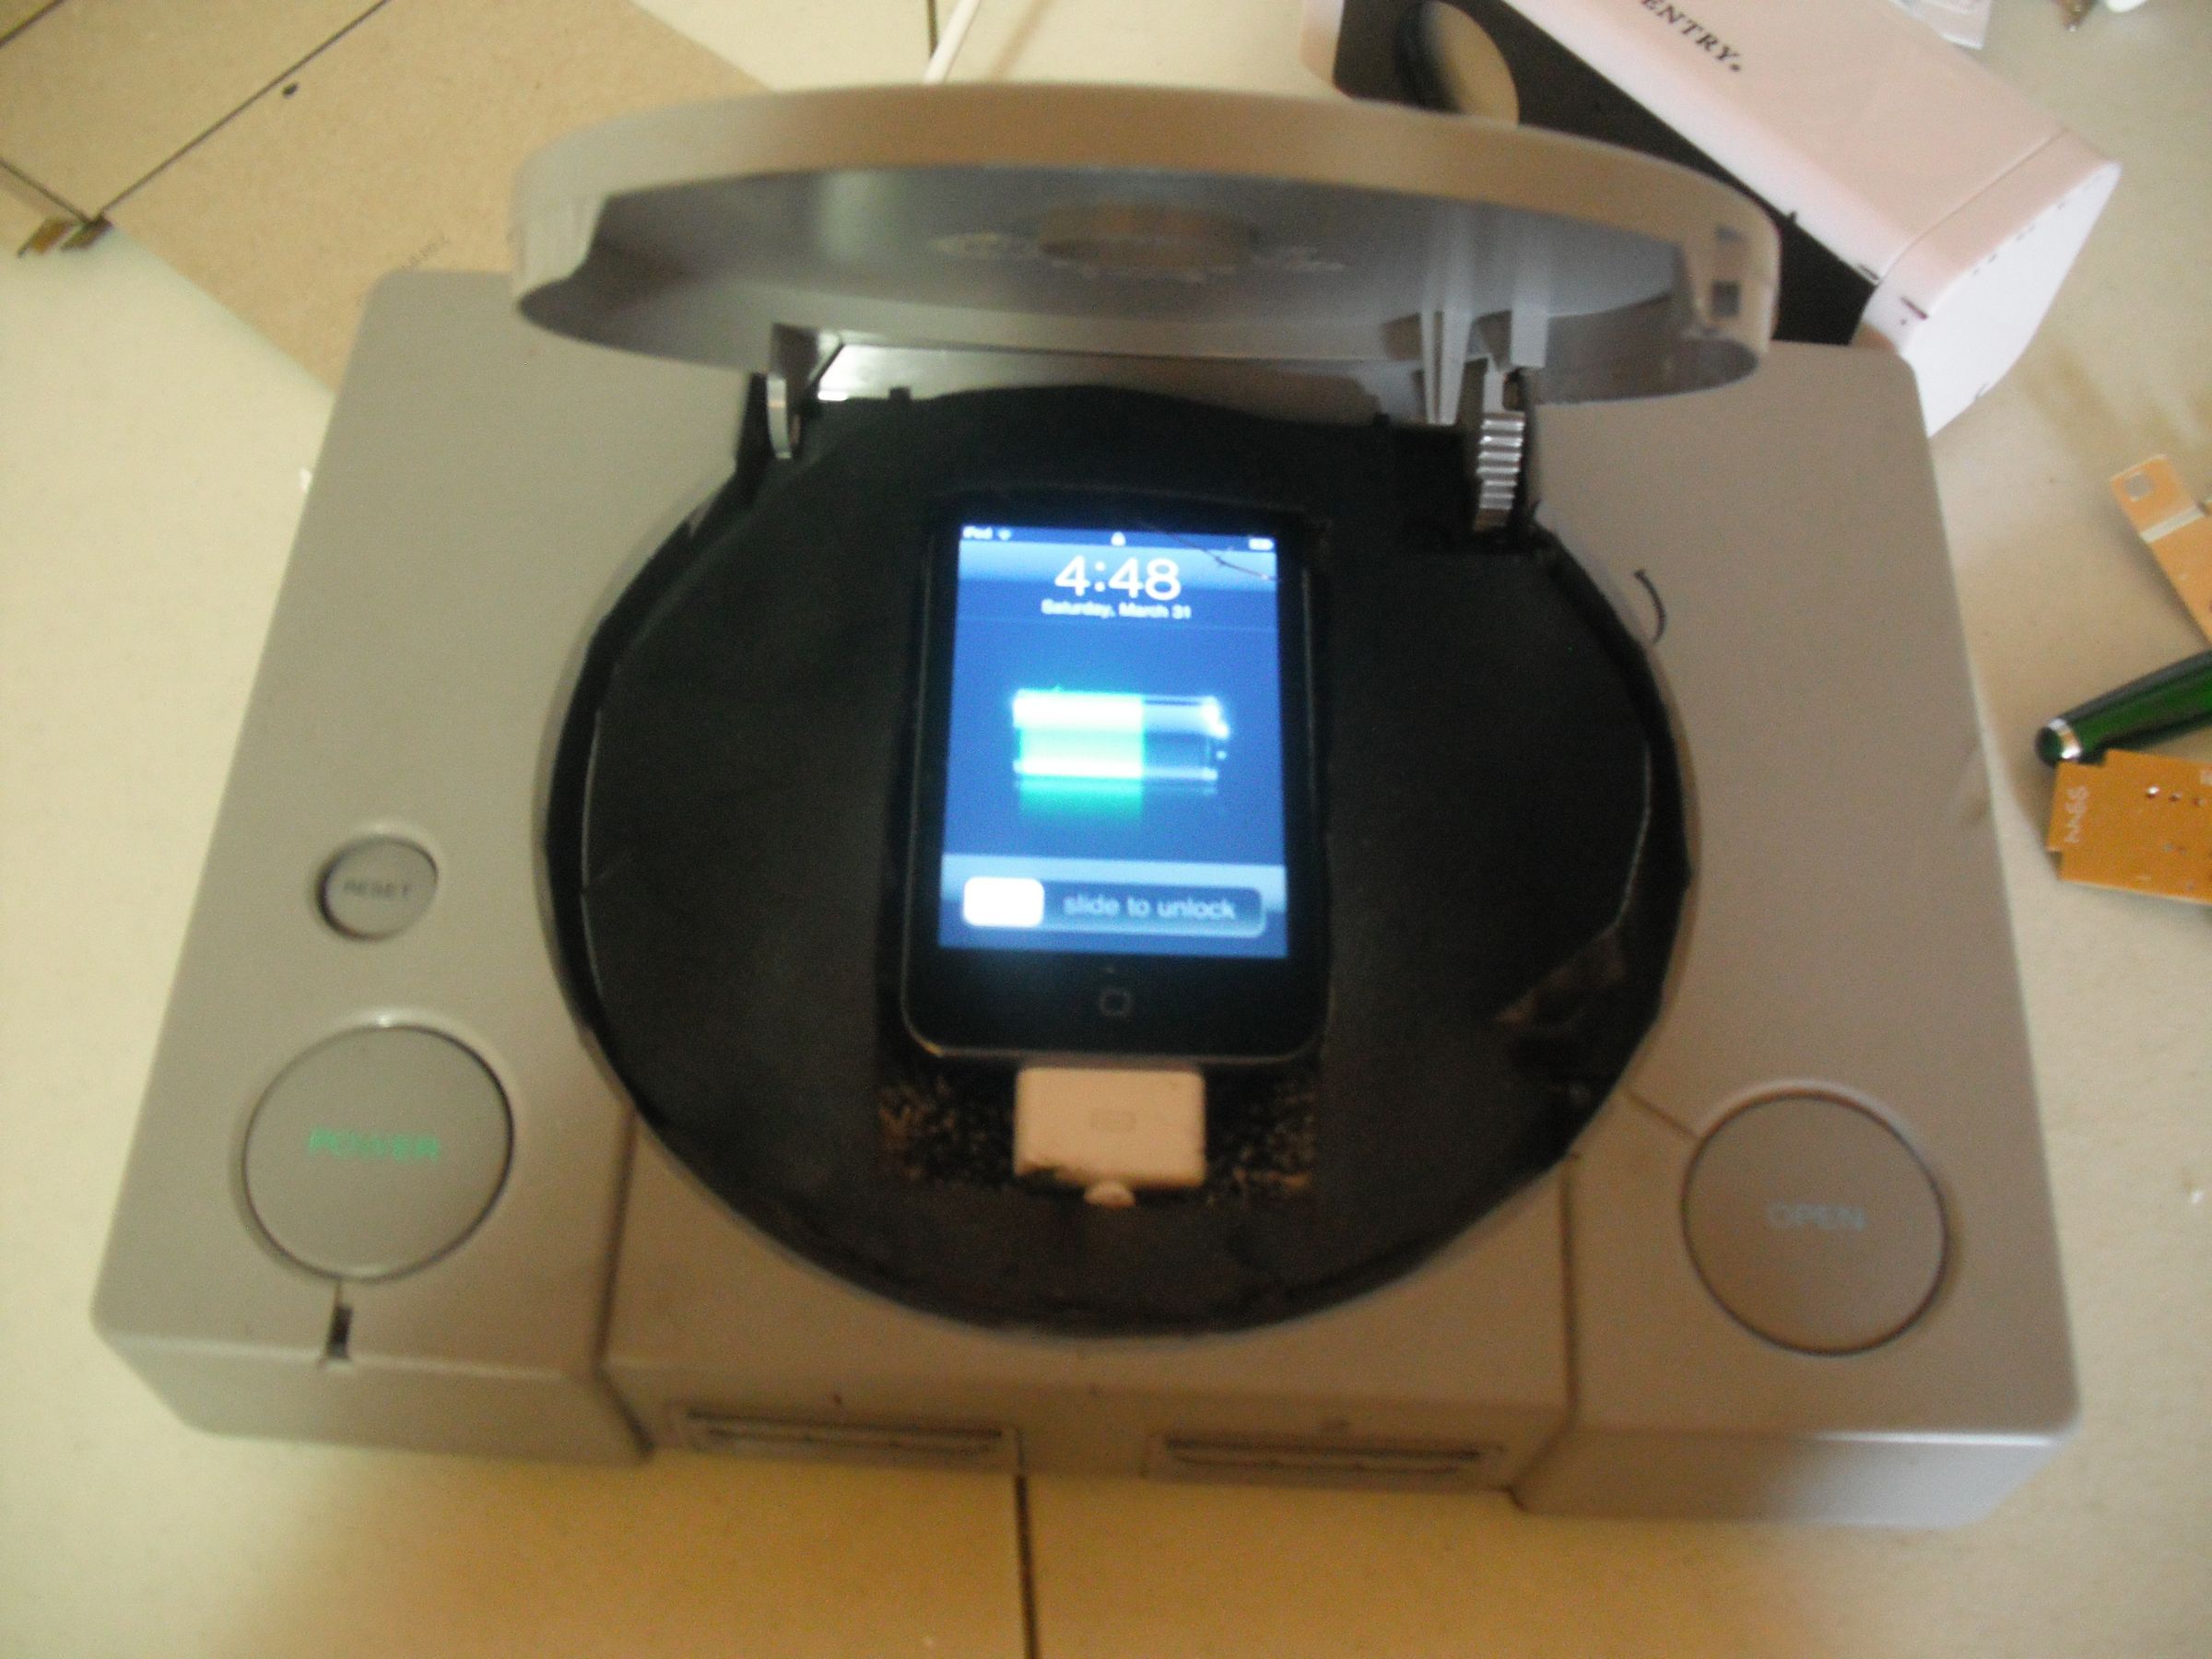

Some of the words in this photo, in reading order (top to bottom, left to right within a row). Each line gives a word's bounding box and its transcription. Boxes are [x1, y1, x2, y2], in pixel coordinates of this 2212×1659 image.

[1054, 555, 1182, 601] 4:48
[1118, 602, 1170, 618] March
[1063, 895, 1120, 917] slide
[1126, 897, 1150, 917] to
[1157, 899, 1236, 921] unlock
[307, 1125, 441, 1162] POWER
[1766, 1201, 1867, 1232] OPEN
